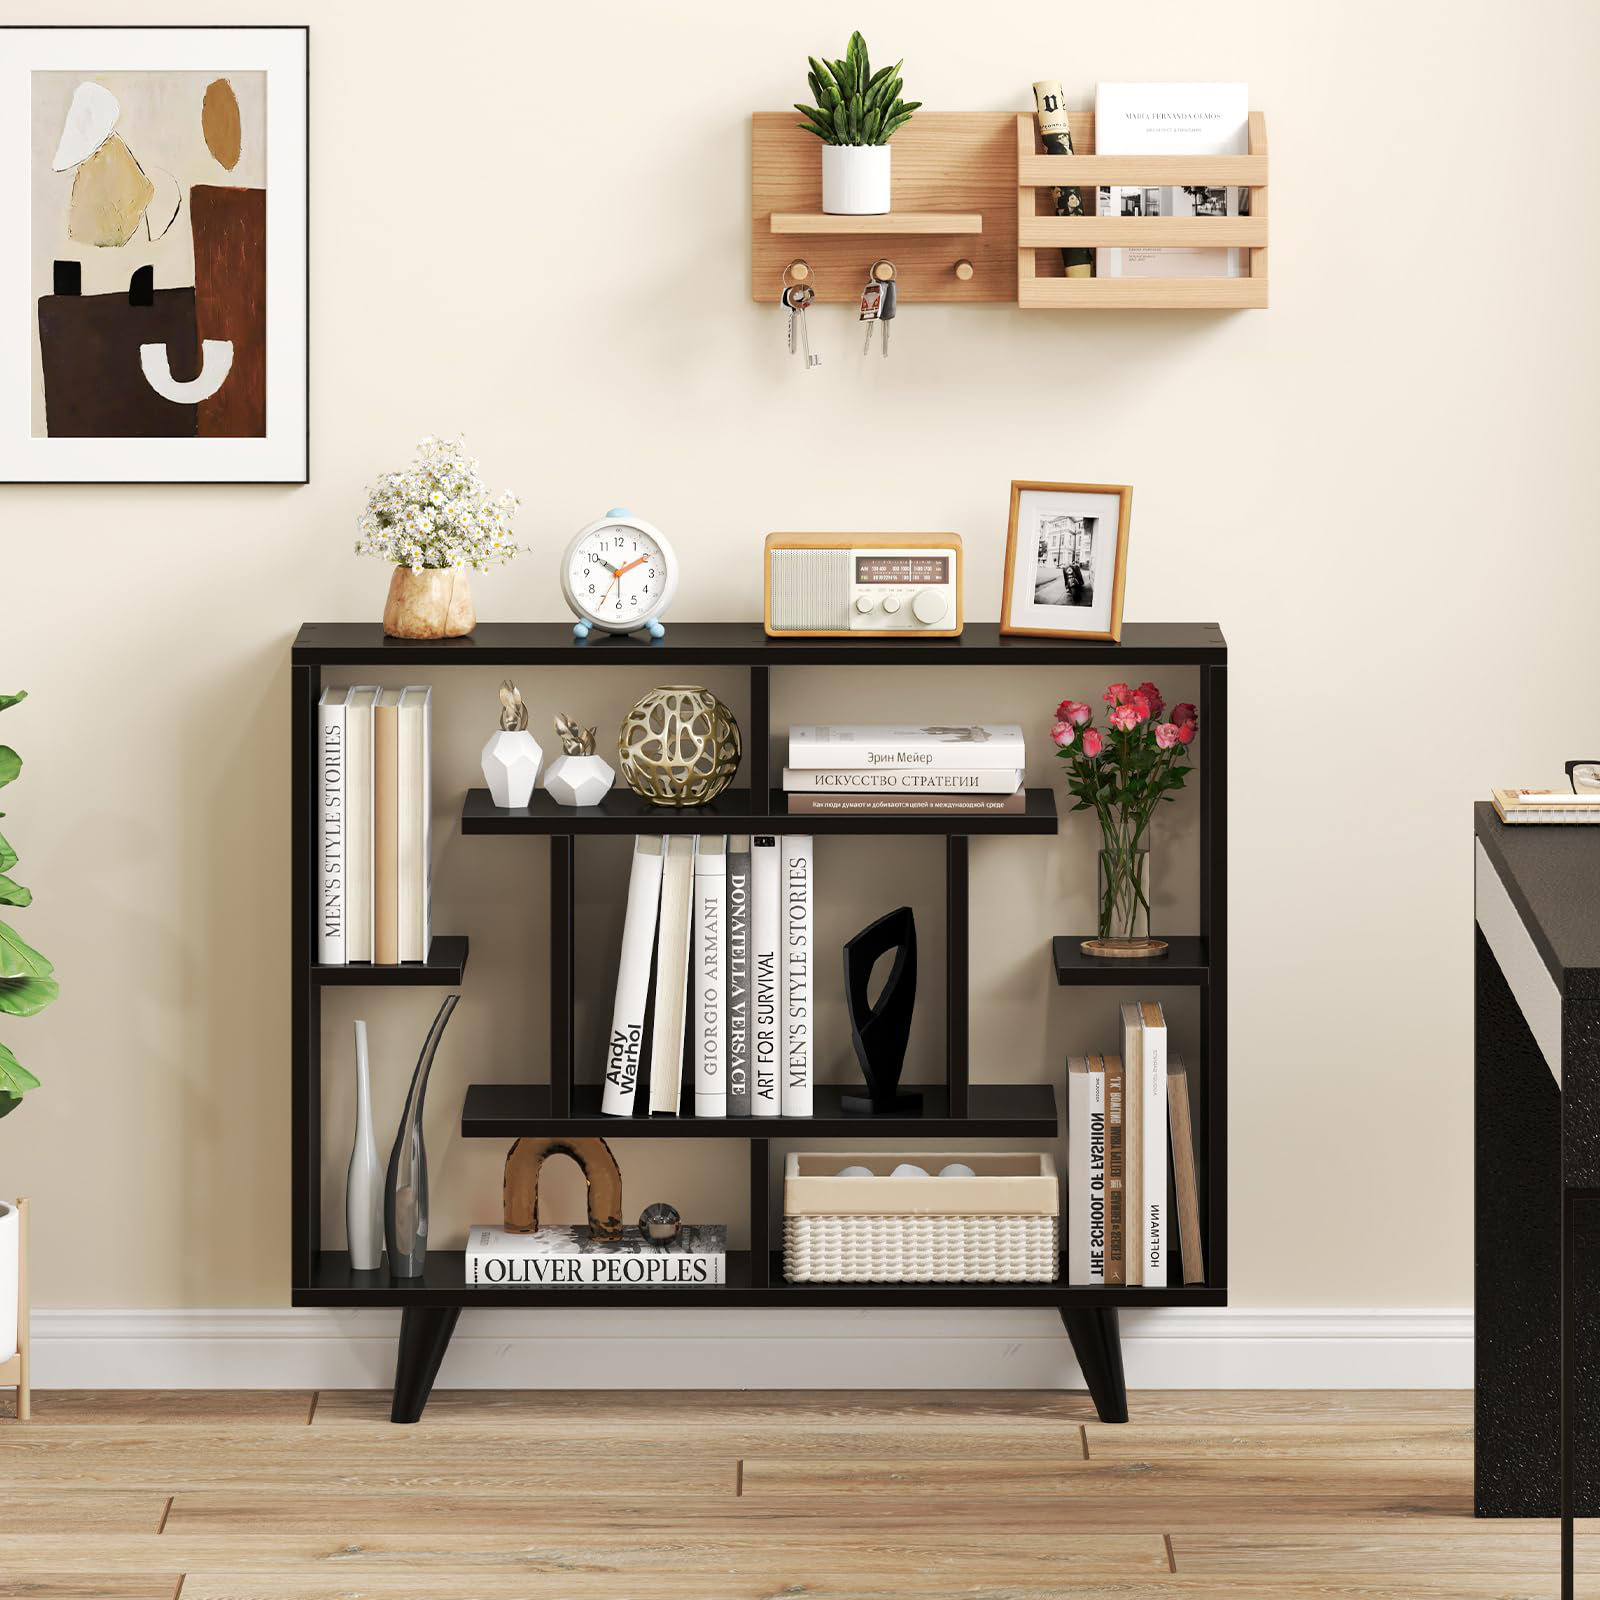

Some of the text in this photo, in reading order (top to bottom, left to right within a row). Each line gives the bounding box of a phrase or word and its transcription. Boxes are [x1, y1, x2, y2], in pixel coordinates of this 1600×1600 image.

[600, 542, 608, 551] 11
[614, 537, 624, 547] 12
[633, 542, 637, 551] 1
[587, 553, 599, 563] 10
[583, 568, 590, 578] 9
[648, 568, 655, 578] 3
[588, 584, 596, 594] 8
[642, 584, 648, 594] 4
[600, 595, 606, 605] 7
[615, 600, 622, 610] 6
[630, 595, 638, 605] 5
[867, 751, 933, 765] Эрин Мейер
[815, 775, 980, 787] ИСКУССТВО СТРАТЕГИИ
[841, 801, 865, 809] думают
[986, 801, 1005, 809] среде
[325, 725, 341, 938] MEN'S STYLE STORIES
[789, 857, 807, 1088] MEN'S STYLE STORIES
[704, 896, 718, 1076] GIORGIO ARMANI
[731, 873, 746, 1095] DONATELLA VERSACE
[757, 951, 774, 1100] ART FOR SURVIVAL
[606, 1030, 628, 1086] Andy
[619, 1023, 641, 1095] Warhol
[484, 1258, 584, 1282] OLIVER
[592, 1258, 707, 1282] PEOPLES
